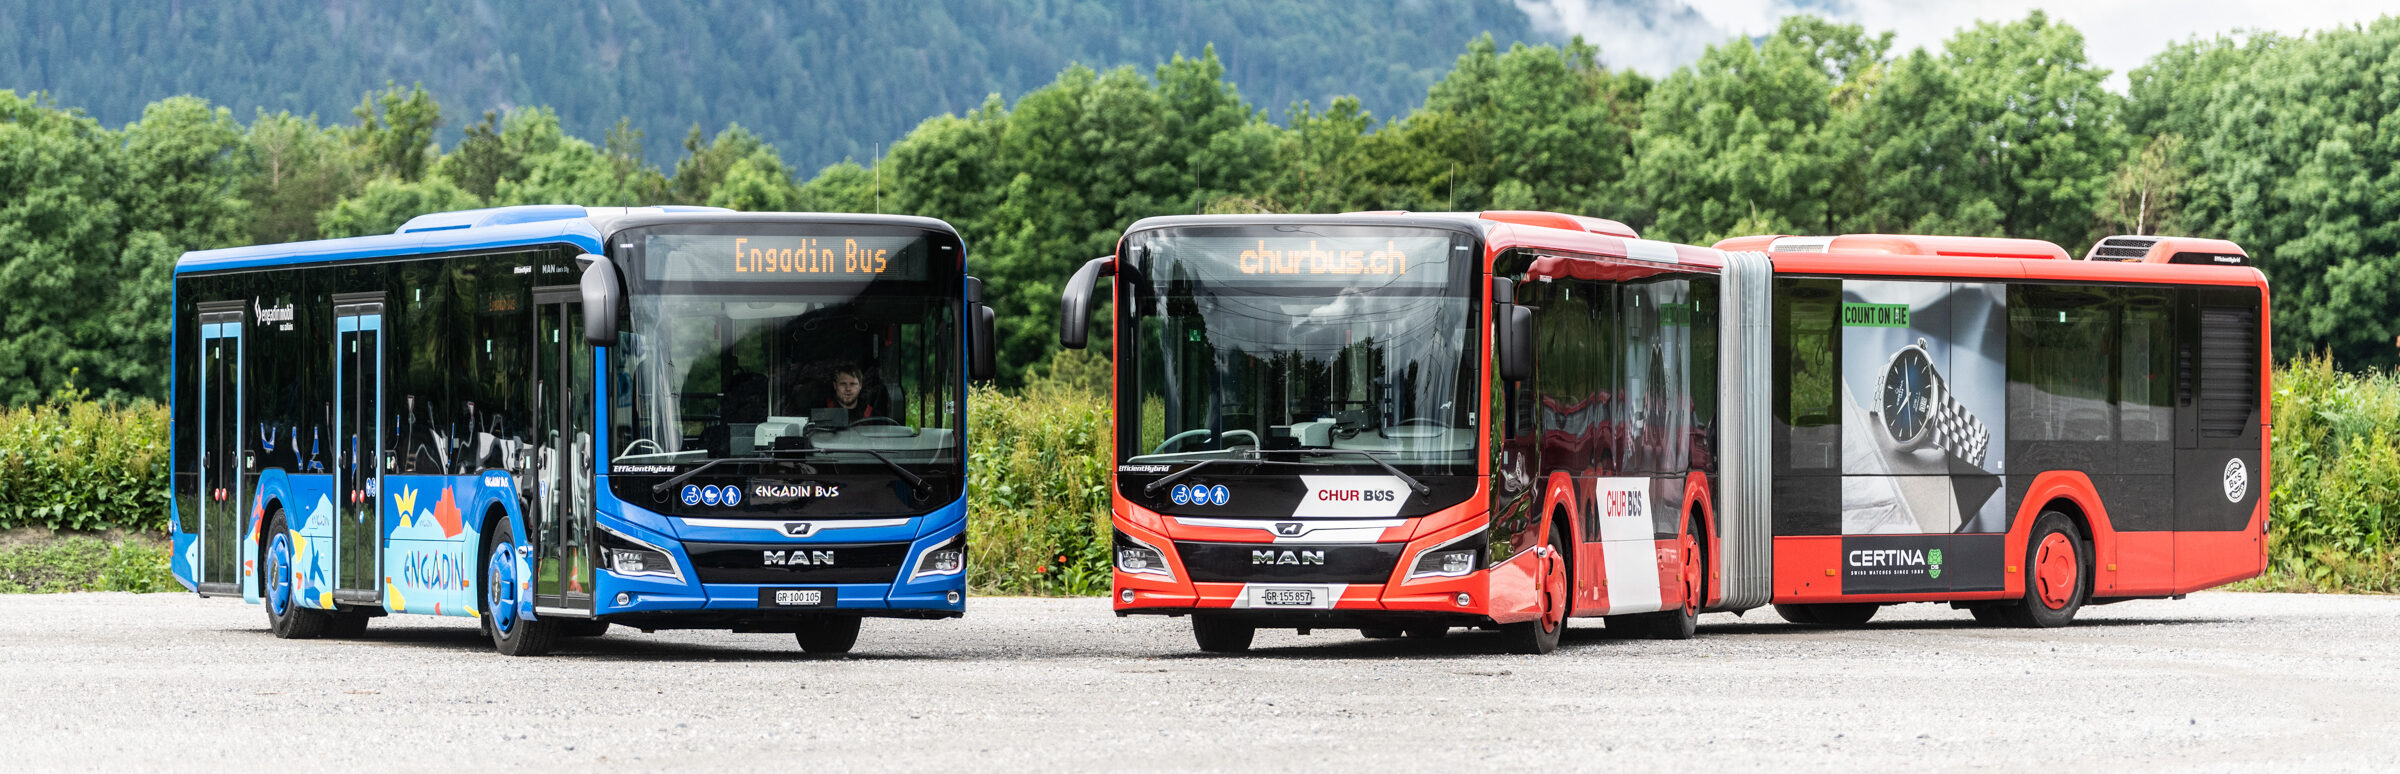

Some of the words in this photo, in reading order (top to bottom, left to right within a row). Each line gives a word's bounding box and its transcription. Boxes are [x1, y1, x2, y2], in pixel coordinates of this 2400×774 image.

[735, 237, 835, 273] Engadin
[845, 238, 888, 273] Bus
[1239, 239, 1407, 275] churbus.ch
[1845, 306, 1876, 324] COUNT
[1878, 307, 1891, 324] ON
[613, 465, 676, 474] EfficientHybrid
[755, 485, 811, 498] ENGADIN
[815, 486, 839, 498] BUS
[1318, 489, 1360, 502] CHUR
[1363, 489, 1395, 502] BUS
[1606, 489, 1627, 518] CHUR
[1627, 490, 1642, 517] BUS
[763, 550, 835, 565] MAN
[1252, 550, 1325, 565] MAN
[1849, 549, 1926, 567] CERTINA
[404, 549, 465, 592] ENGADIN
